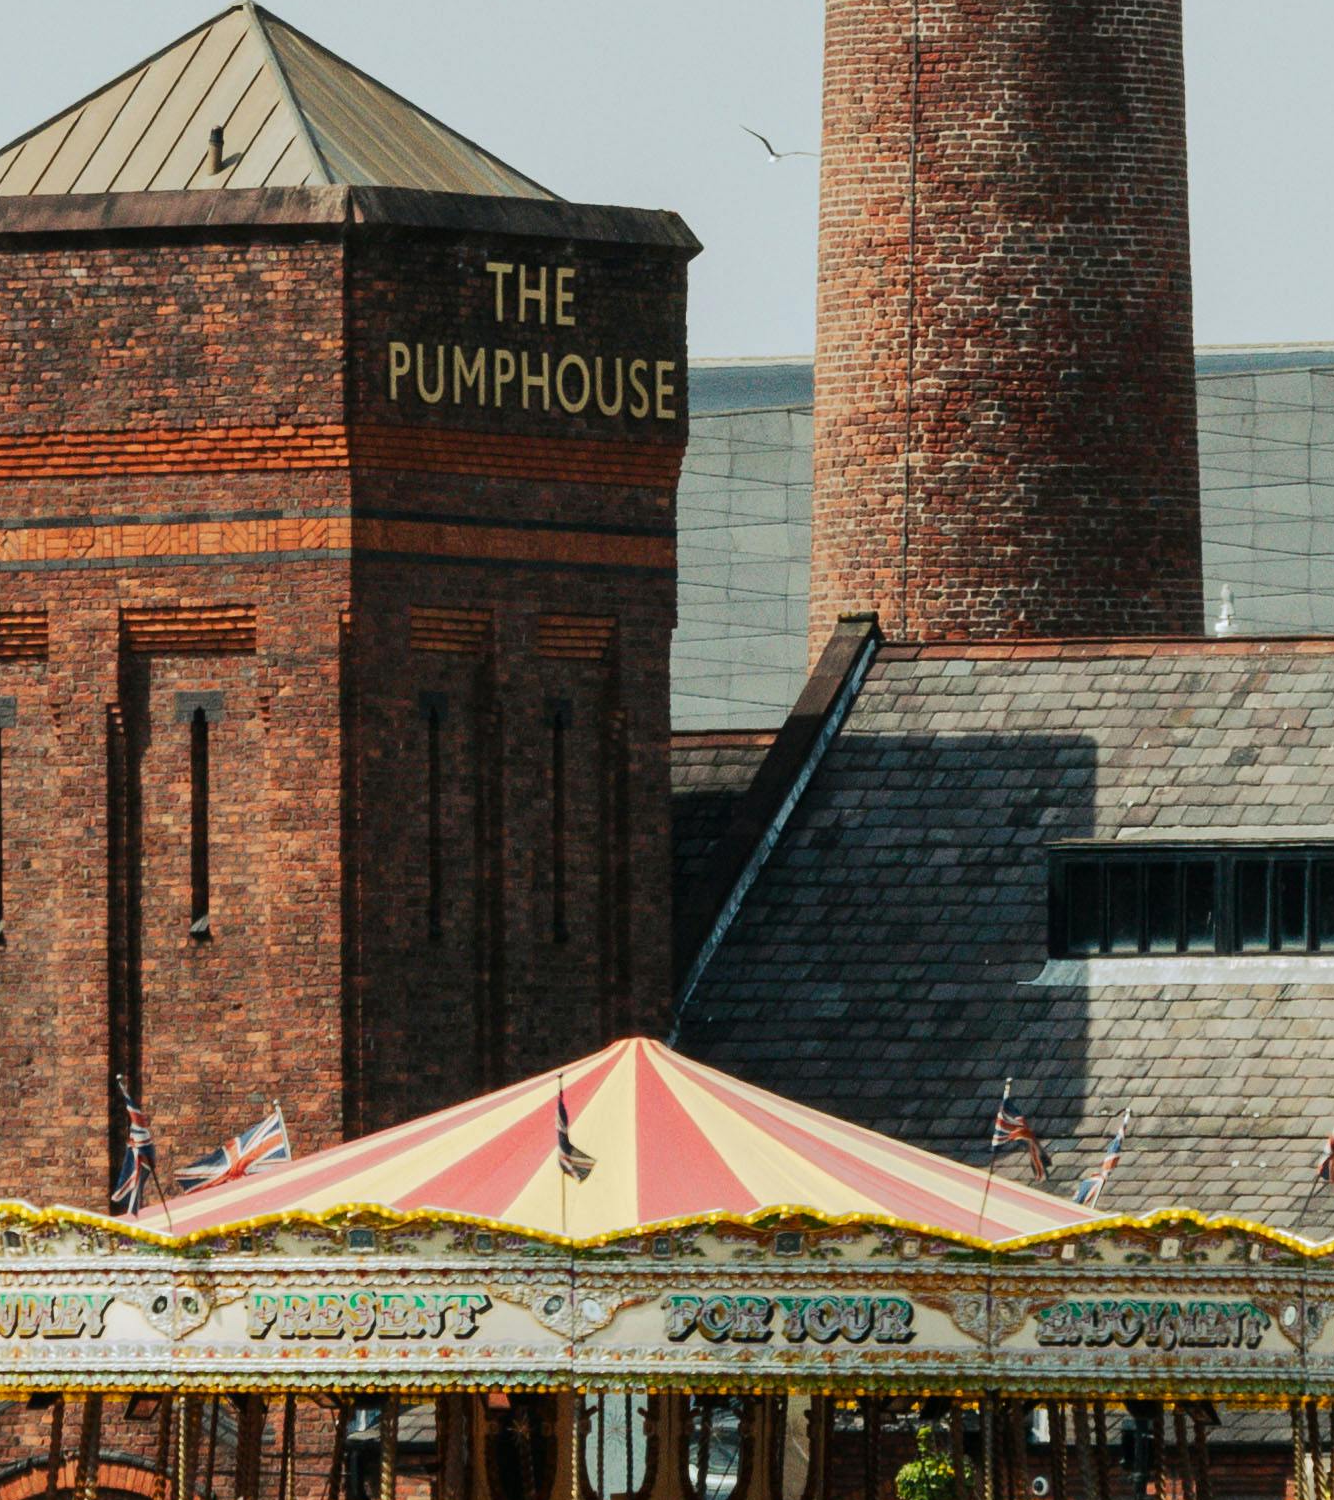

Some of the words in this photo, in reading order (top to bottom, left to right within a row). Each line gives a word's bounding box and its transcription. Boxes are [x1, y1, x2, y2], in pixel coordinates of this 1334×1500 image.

[486, 262, 576, 326] THE
[388, 342, 676, 420] PUMPHOUSE
[245, 1292, 493, 1342] PRESENT
[664, 1295, 773, 1343] FOR
[773, 1295, 917, 1344] YOUR
[1035, 1300, 1270, 1350] ENJOYMENT
